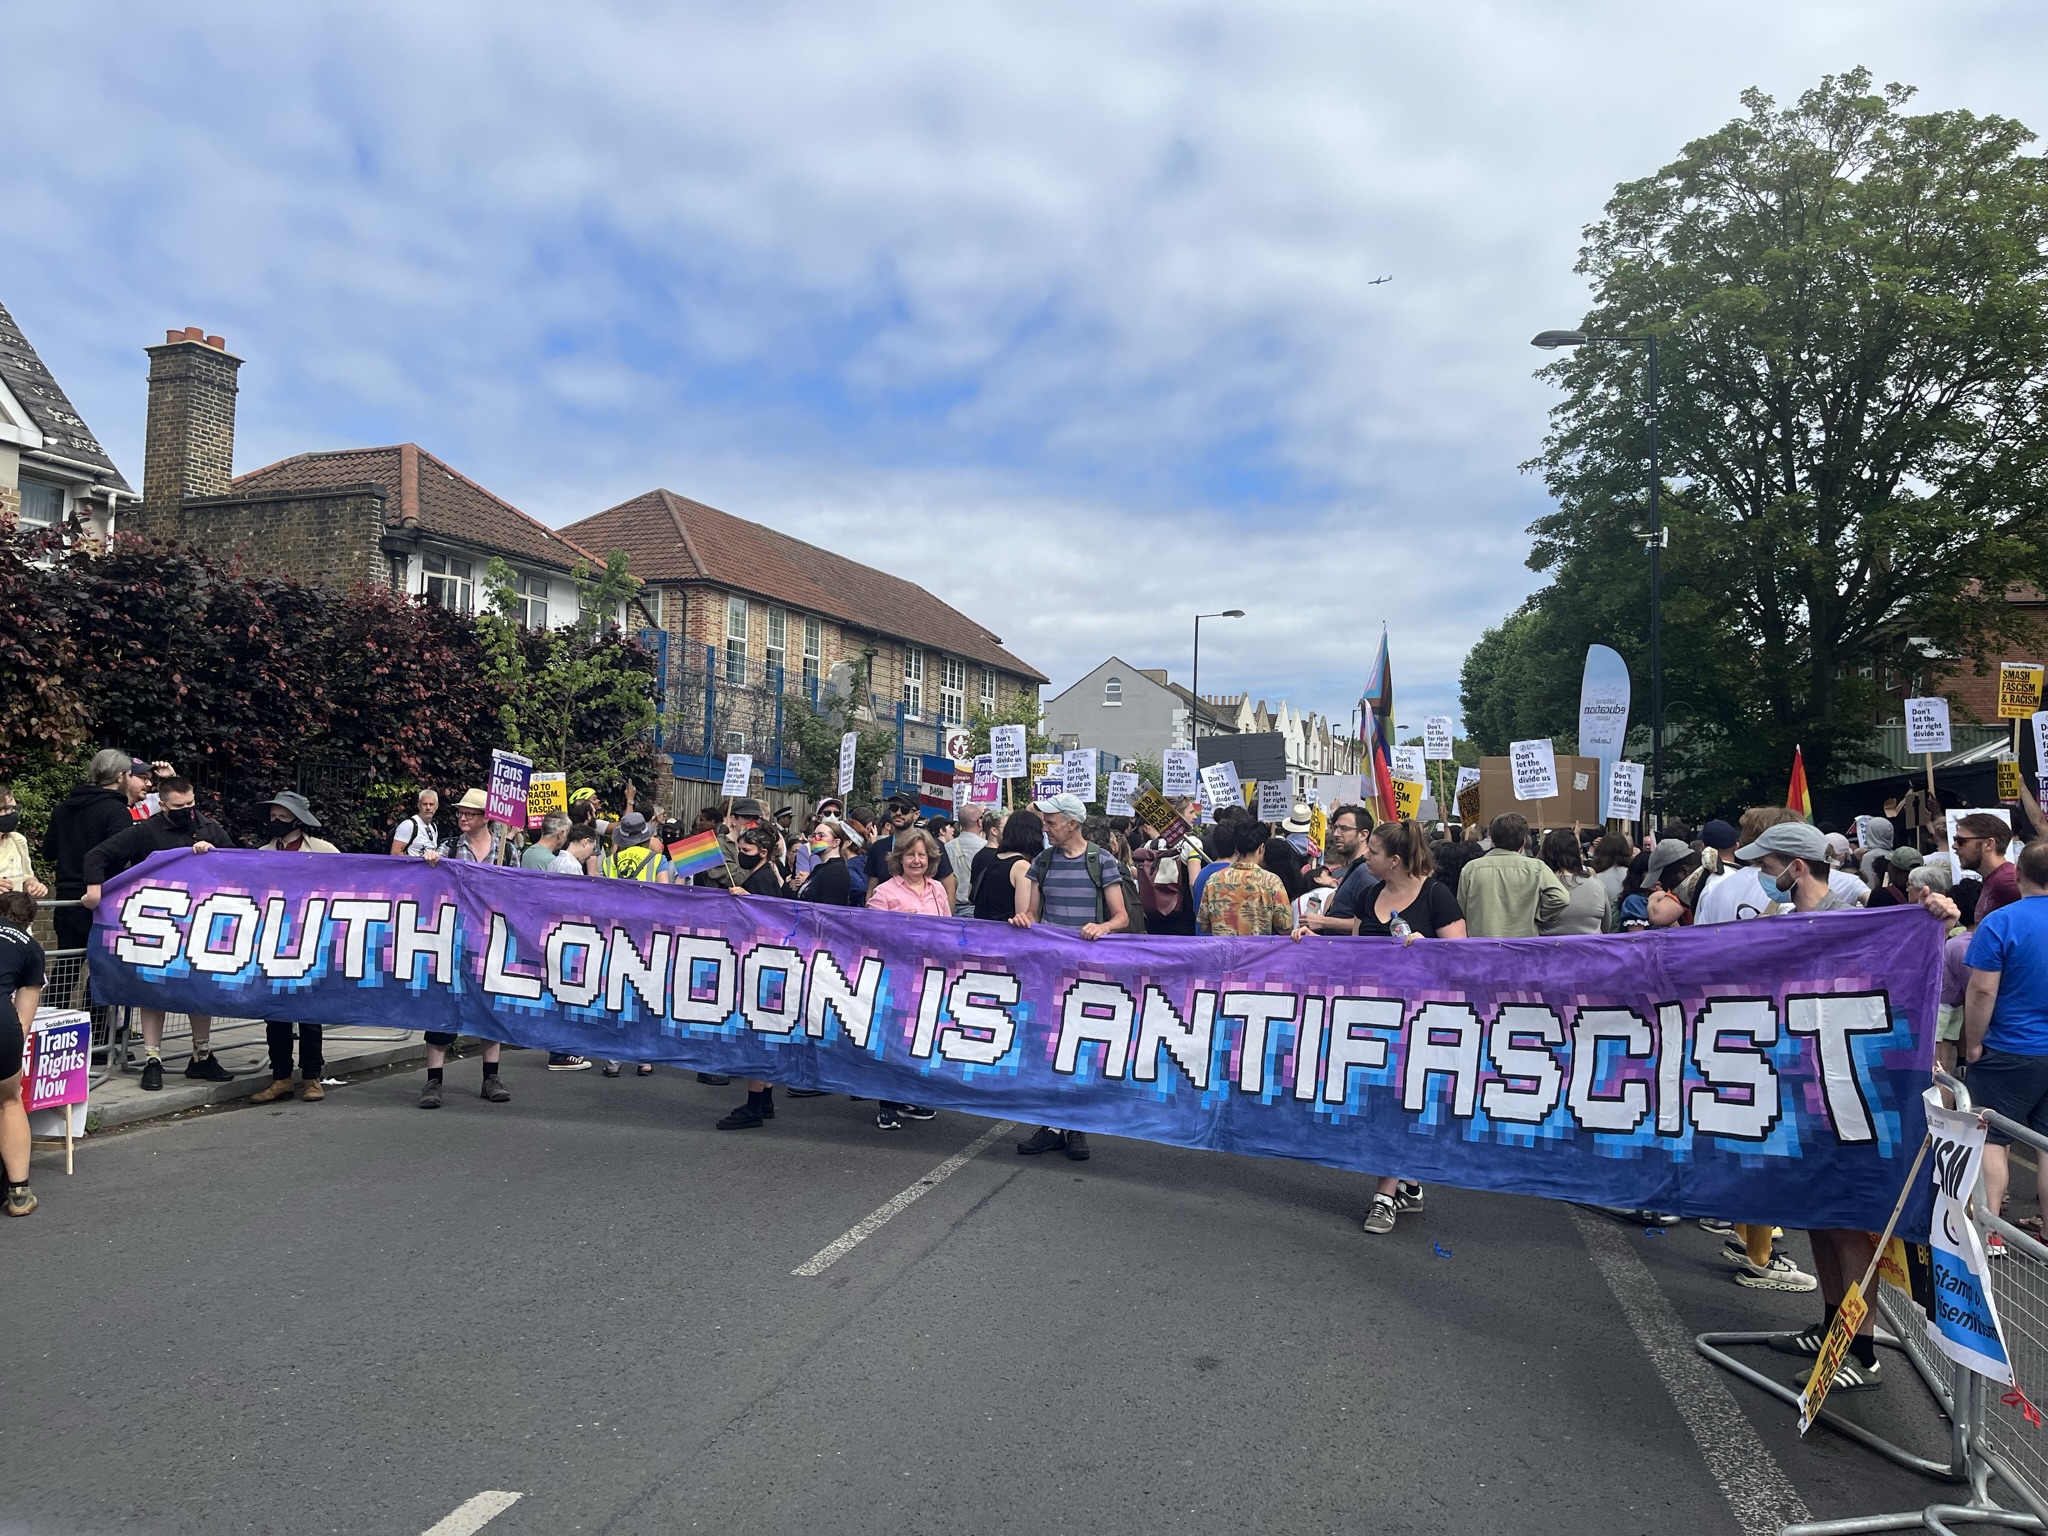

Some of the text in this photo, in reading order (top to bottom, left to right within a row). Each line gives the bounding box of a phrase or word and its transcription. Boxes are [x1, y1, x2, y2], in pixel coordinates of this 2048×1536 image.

[2002, 670, 2030, 680] SMASH
[2002, 682, 2036, 692] FASCISM
[2001, 694, 2039, 705] & RACISM
[1516, 752, 1534, 760] Don't
[493, 758, 523, 782] Trans
[975, 760, 992, 772] Trans
[1518, 767, 1547, 776] far right
[1614, 772, 1631, 780] Don't
[975, 772, 997, 786] Rights
[1076, 773, 1089, 781] right
[1519, 776, 1540, 784] divide
[491, 776, 527, 802] Rights
[973, 785, 988, 796] Now
[1036, 782, 1061, 794] Trans
[1222, 787, 1236, 795] right
[1393, 781, 1404, 791] TO
[528, 790, 560, 798] RACISM.
[930, 786, 943, 797] BASH
[1142, 796, 1152, 805] TO
[1215, 795, 1231, 803] divide
[1394, 791, 1411, 803] ISM.
[489, 794, 514, 817] Now
[529, 805, 562, 813] FASCISM
[1155, 809, 1165, 817] TO
[116, 886, 1893, 1143] SOUTH LONDON IS ANTIFASCIST
[45, 1020, 65, 1028] Socialist
[39, 1030, 78, 1053] Trans
[37, 1050, 84, 1078] Rights
[34, 1078, 66, 1100] Now
[1936, 1264, 1973, 1306] Stamp
